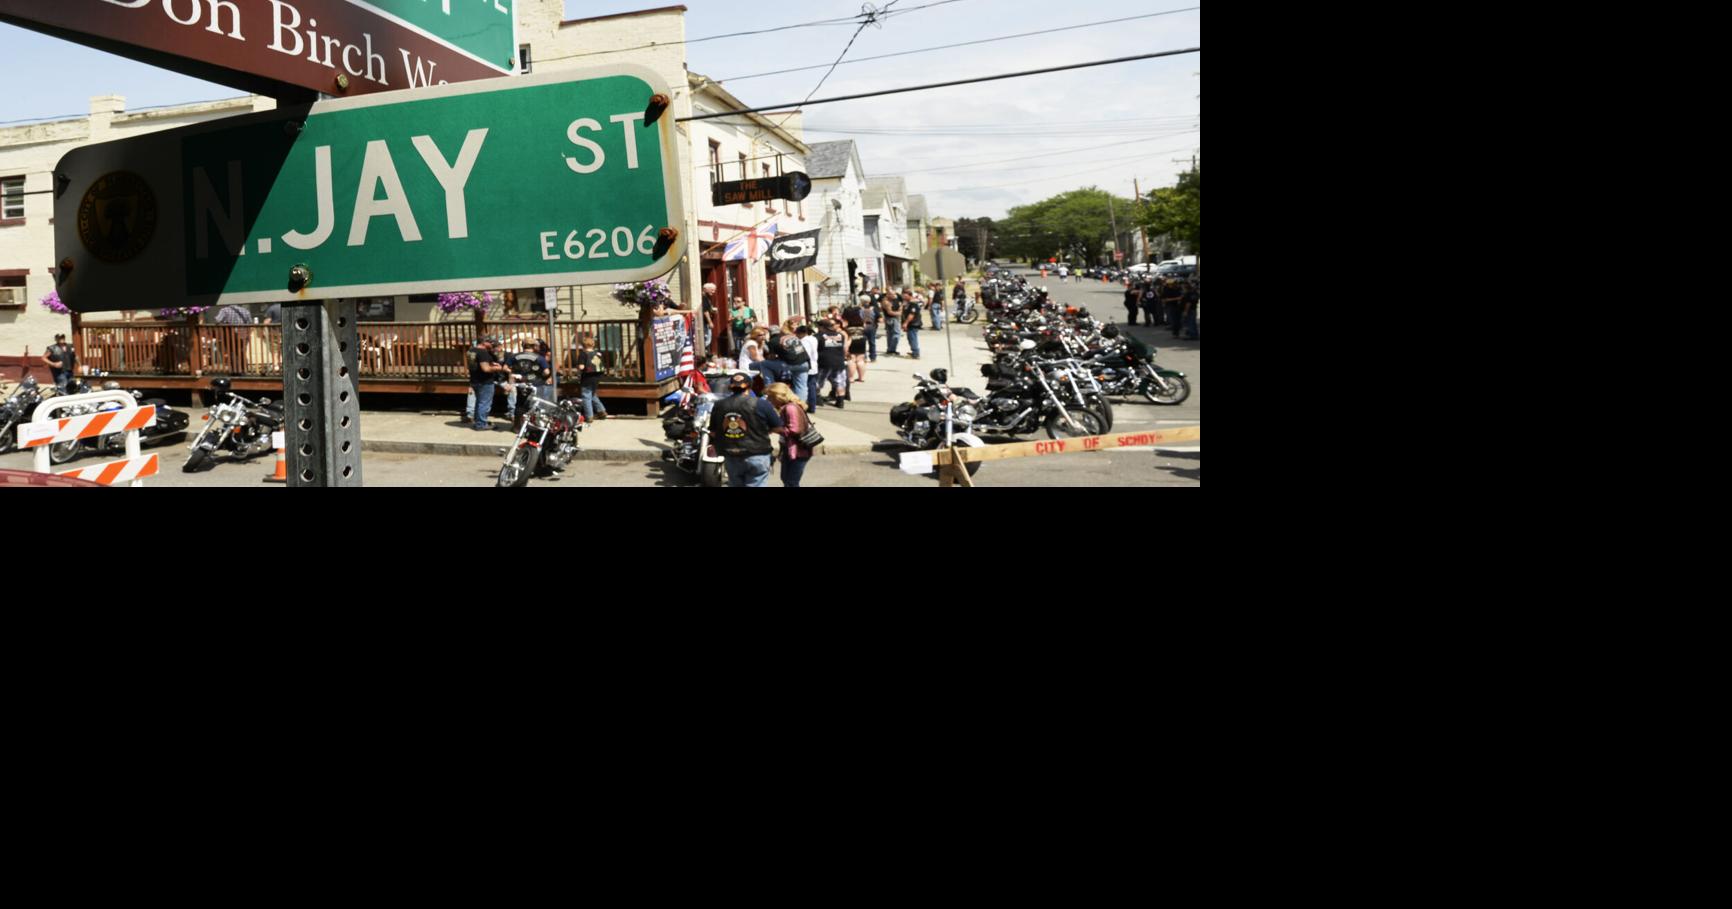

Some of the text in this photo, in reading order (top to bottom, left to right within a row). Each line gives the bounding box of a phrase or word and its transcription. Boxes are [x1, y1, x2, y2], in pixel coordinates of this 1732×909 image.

[100, 0, 246, 41] on
[266, 0, 390, 86] Birch
[565, 111, 647, 174] ST
[724, 190, 773, 201] SAW MILL
[740, 180, 757, 190] THE
[540, 225, 657, 261] E6206
[1035, 441, 1066, 455] CITY
[1083, 437, 1100, 449] OF
